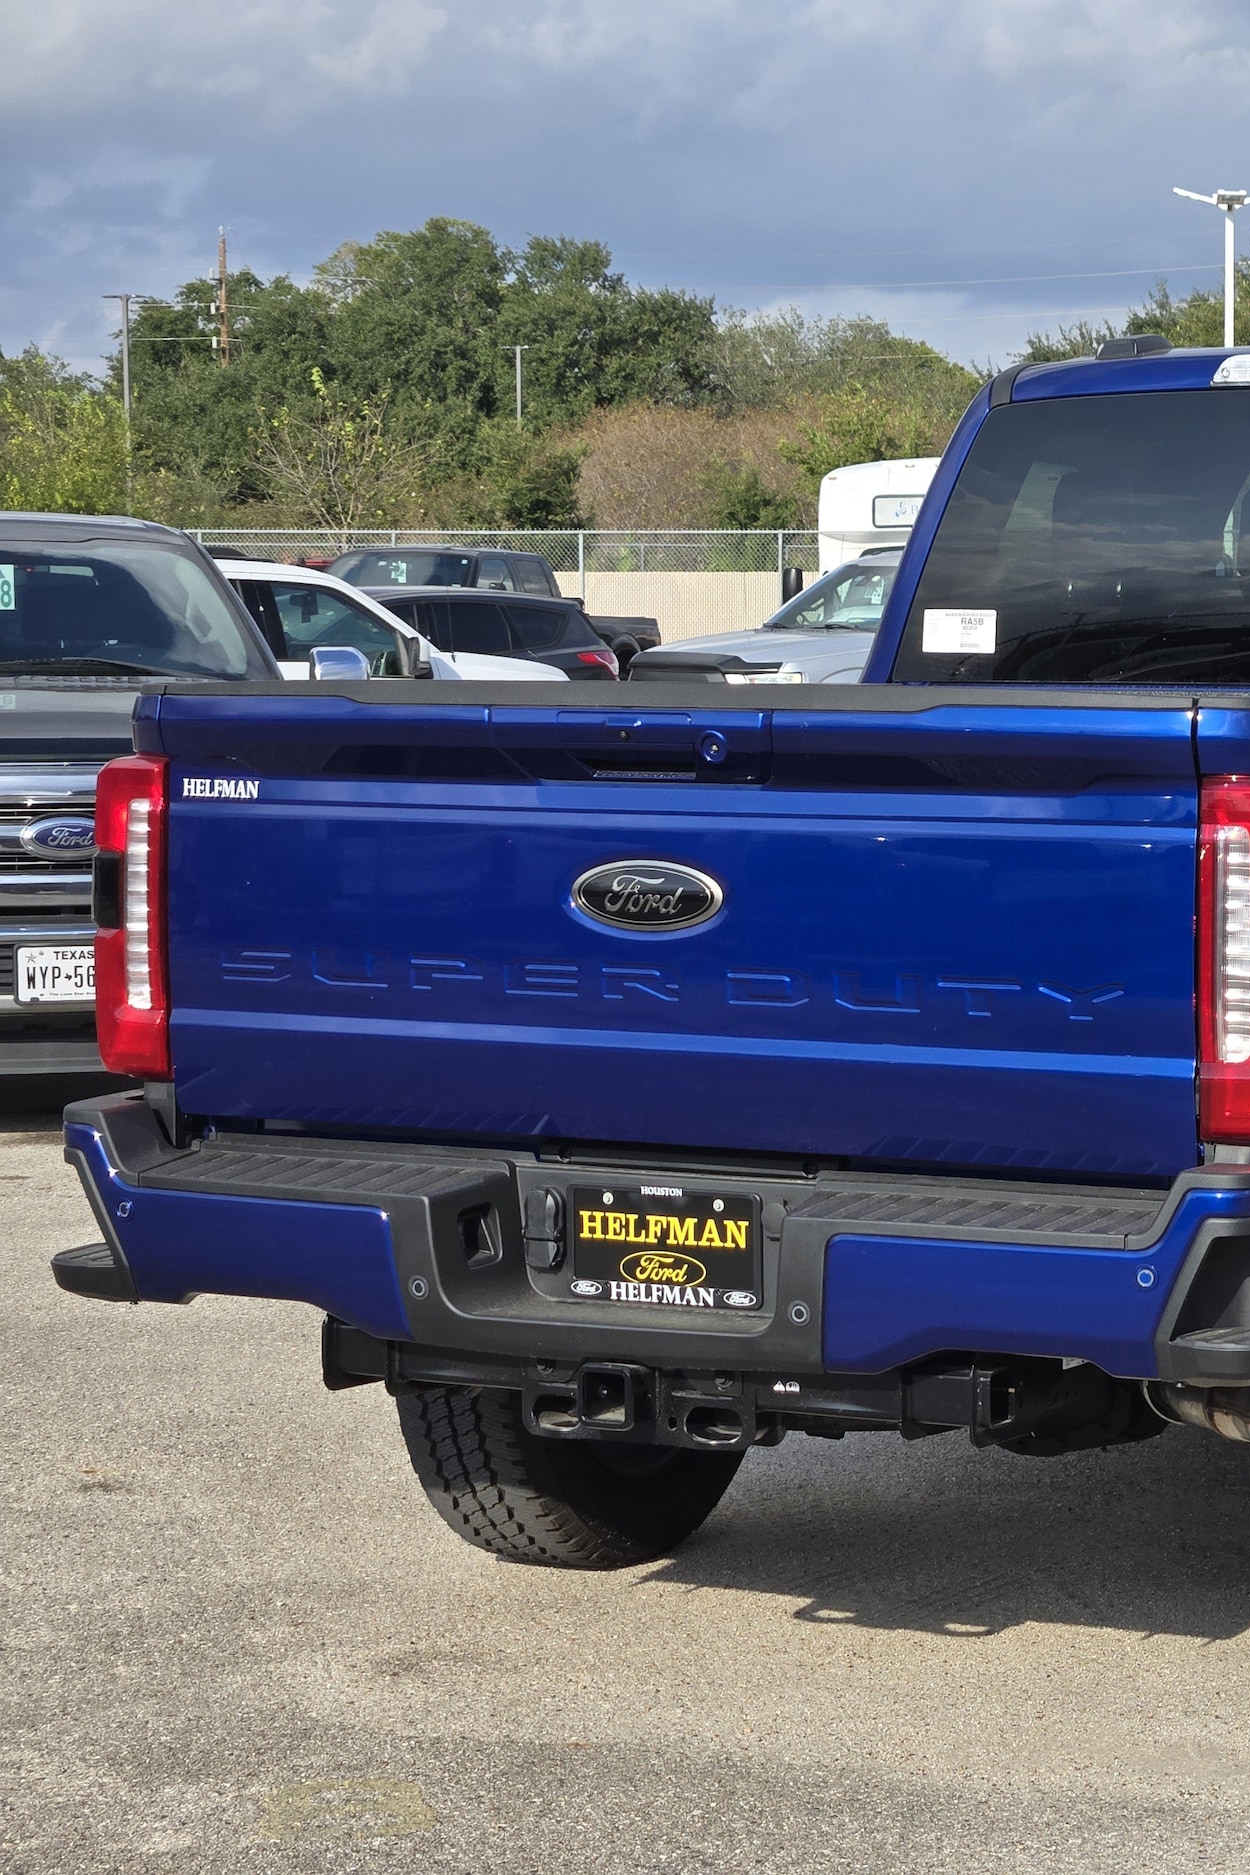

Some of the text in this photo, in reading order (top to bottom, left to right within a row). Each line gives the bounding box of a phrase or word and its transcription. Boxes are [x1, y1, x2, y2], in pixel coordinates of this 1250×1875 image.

[183, 778, 260, 799] HELFMAN
[47, 826, 93, 847] Ford
[604, 874, 685, 915] Ford
[53, 950, 95, 960] TEXAS
[220, 944, 1126, 1022] SUPER DUTY
[640, 1186, 683, 1197] HOUSTON
[579, 1210, 749, 1249] HELFMAN
[636, 1255, 688, 1282] Ford
[573, 1280, 751, 1307] Ford HELFMAN Ford
